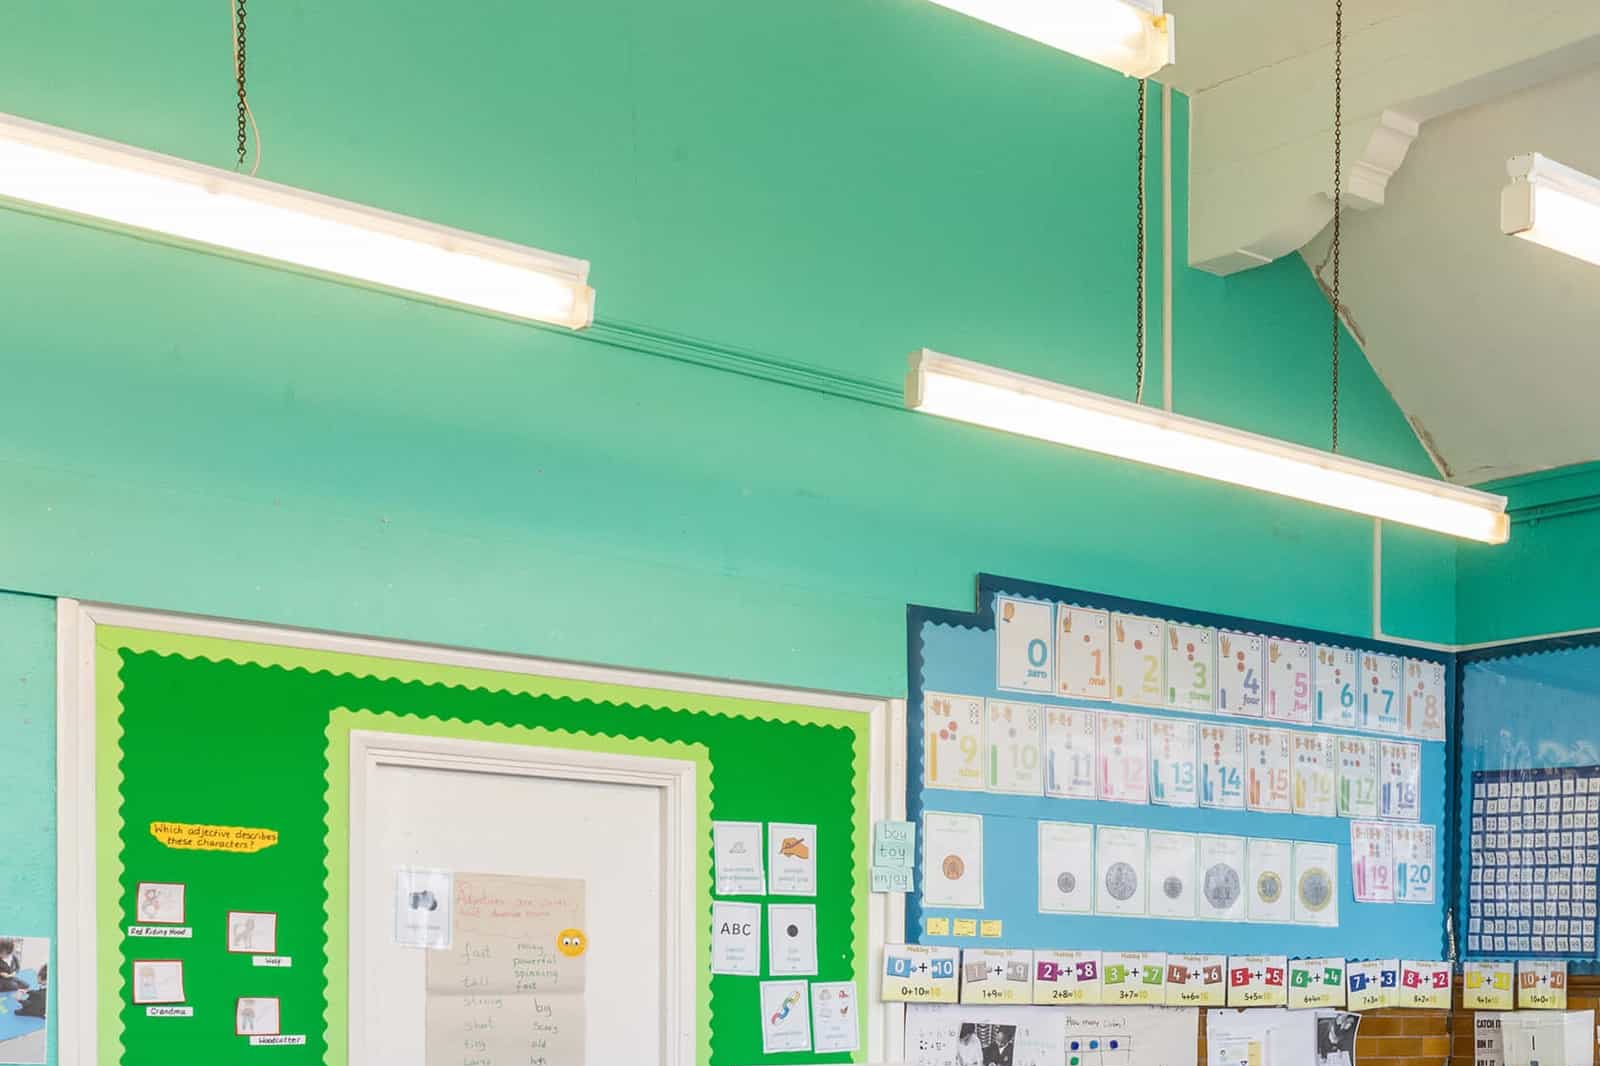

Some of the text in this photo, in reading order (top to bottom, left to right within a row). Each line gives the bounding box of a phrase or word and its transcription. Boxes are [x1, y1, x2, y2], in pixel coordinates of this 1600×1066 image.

[1028, 639, 1048, 667] 0
[1091, 649, 1102, 676] 1
[1143, 655, 1158, 684] 2
[1193, 662, 1207, 689] 3
[1242, 668, 1260, 695] 4
[1294, 672, 1308, 698] 5
[1341, 683, 1354, 708] 6
[1381, 690, 1394, 714] 7
[1424, 695, 1437, 718] 8
[960, 736, 977, 765] 9
[1012, 744, 1038, 770] 10
[1072, 753, 1091, 776] 11
[1122, 757, 1144, 781] 12
[1172, 760, 1194, 785] 13
[1218, 766, 1242, 790] 14
[1267, 768, 1288, 790] 15
[1312, 772, 1332, 794] 16
[1356, 778, 1374, 801] 17
[154, 823, 184, 836] Which
[188, 826, 230, 838] adjective
[167, 836, 192, 846] these
[884, 823, 907, 841] boy
[880, 844, 906, 868] toy
[1372, 864, 1388, 884] 19
[1410, 864, 1432, 884] 20
[720, 922, 752, 936] ABC
[894, 961, 952, 975] 0 10
[1044, 963, 1094, 976] 2 8
[1110, 968, 1158, 982] 3 7
[1173, 967, 1218, 982] 4 6
[1236, 970, 1280, 984] 5 5
[1296, 968, 1338, 985] 6 4
[1406, 972, 1448, 986] 8 2
[1353, 971, 1393, 988] 7 3
[1052, 990, 1083, 1000] 2+8=10
[150, 1008, 187, 1016] Grandma
[1476, 1020, 1493, 1028] CATCH
